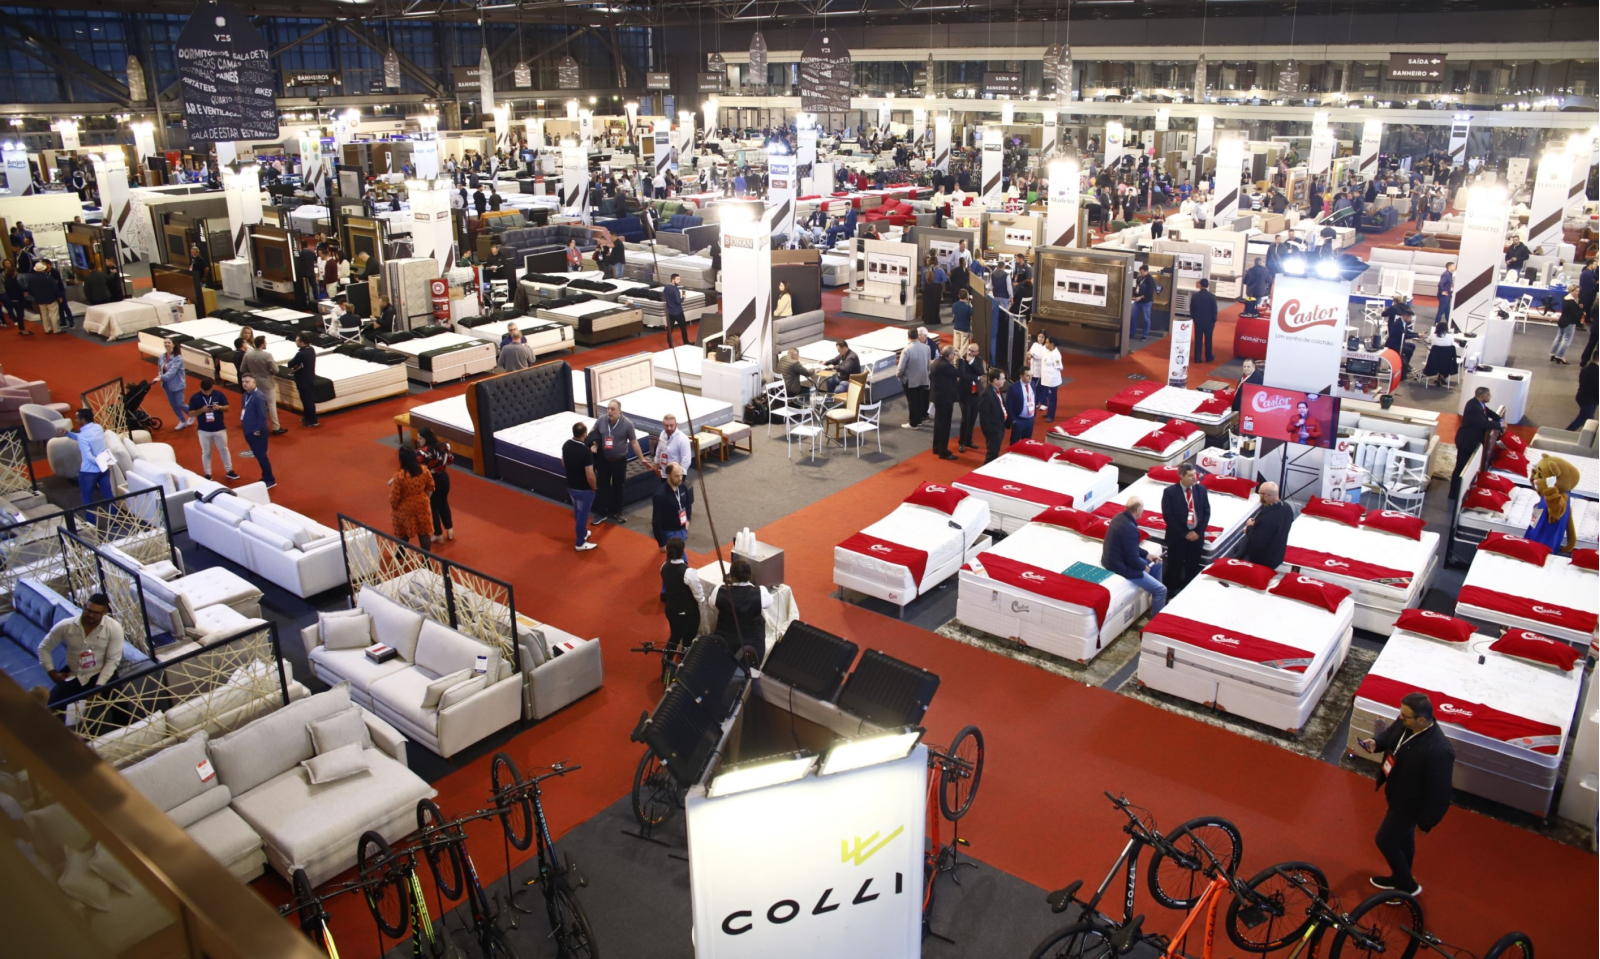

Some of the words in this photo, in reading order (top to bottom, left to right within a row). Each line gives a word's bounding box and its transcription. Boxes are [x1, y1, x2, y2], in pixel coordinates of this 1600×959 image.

[214, 34, 231, 42] YES
[232, 52, 250, 60] SALA
[250, 51, 259, 59] DE
[259, 49, 269, 60] TV
[1408, 57, 1429, 65] SAÍDA
[185, 102, 197, 115] AR
[191, 130, 209, 140] SALA
[219, 127, 239, 139] ESTAR
[1467, 223, 1499, 233] AGRATTO
[1277, 298, 1339, 333] Castor
[1346, 351, 1375, 360] AGRATTO
[1251, 390, 1292, 413] Castor
[1126, 866, 1137, 907] COLLI
[721, 871, 903, 936] COLLI
